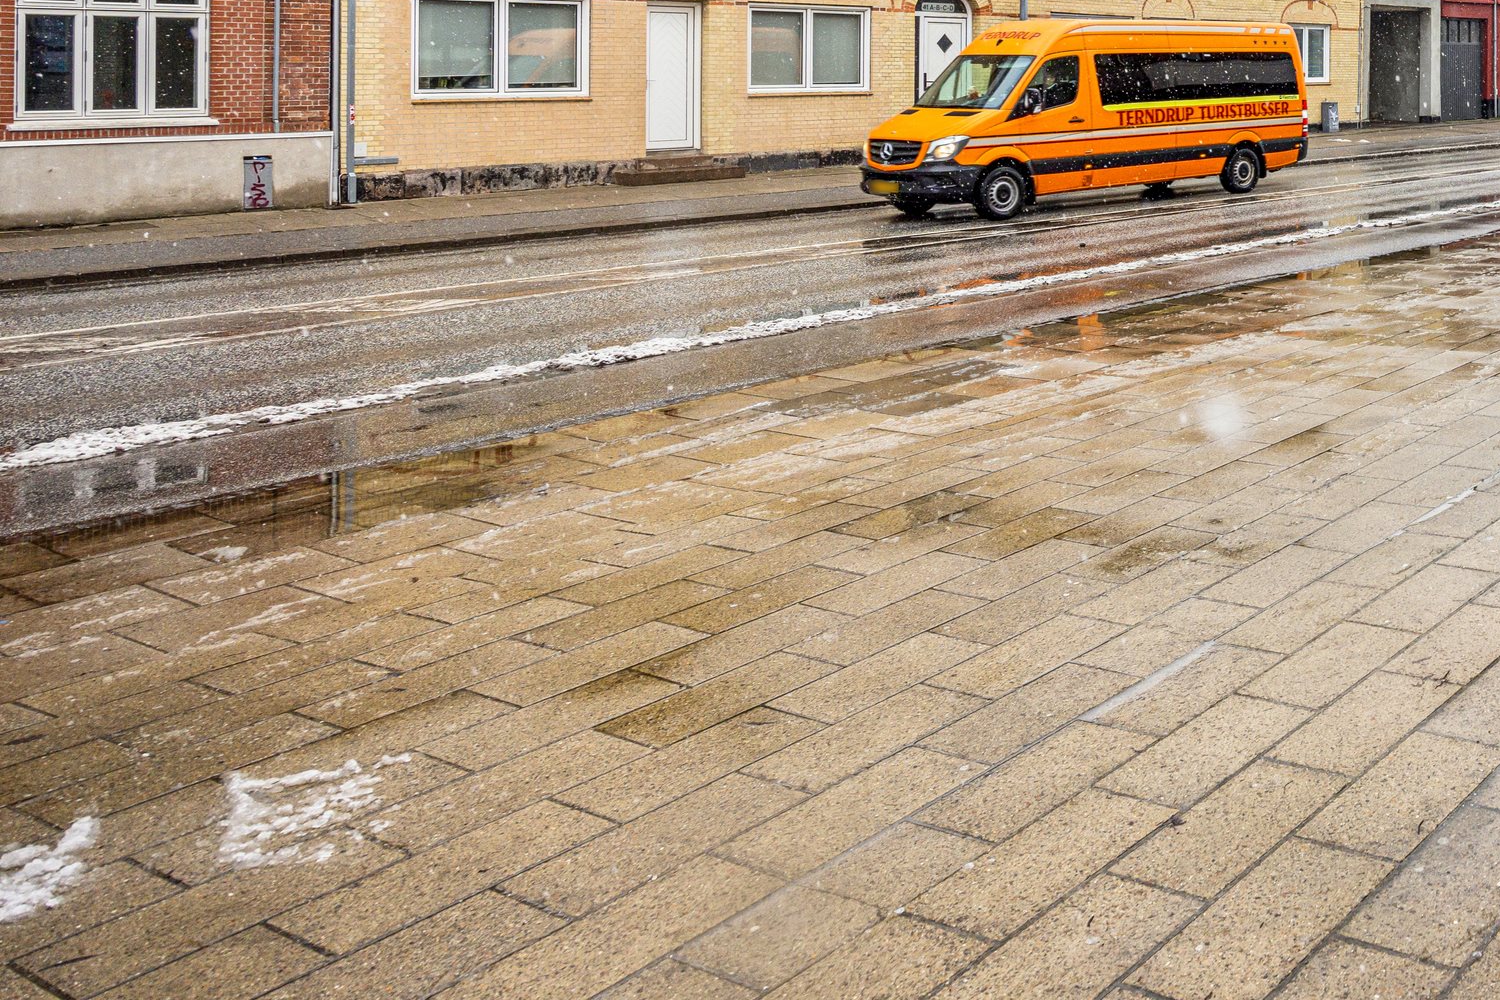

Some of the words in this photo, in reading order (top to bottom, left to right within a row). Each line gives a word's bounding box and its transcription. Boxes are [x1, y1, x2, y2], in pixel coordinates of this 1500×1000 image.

[981, 31, 1041, 41] TERNDRUP
[1116, 106, 1194, 126] TERNDRUP
[1199, 101, 1290, 121] TURISTBUSSER
